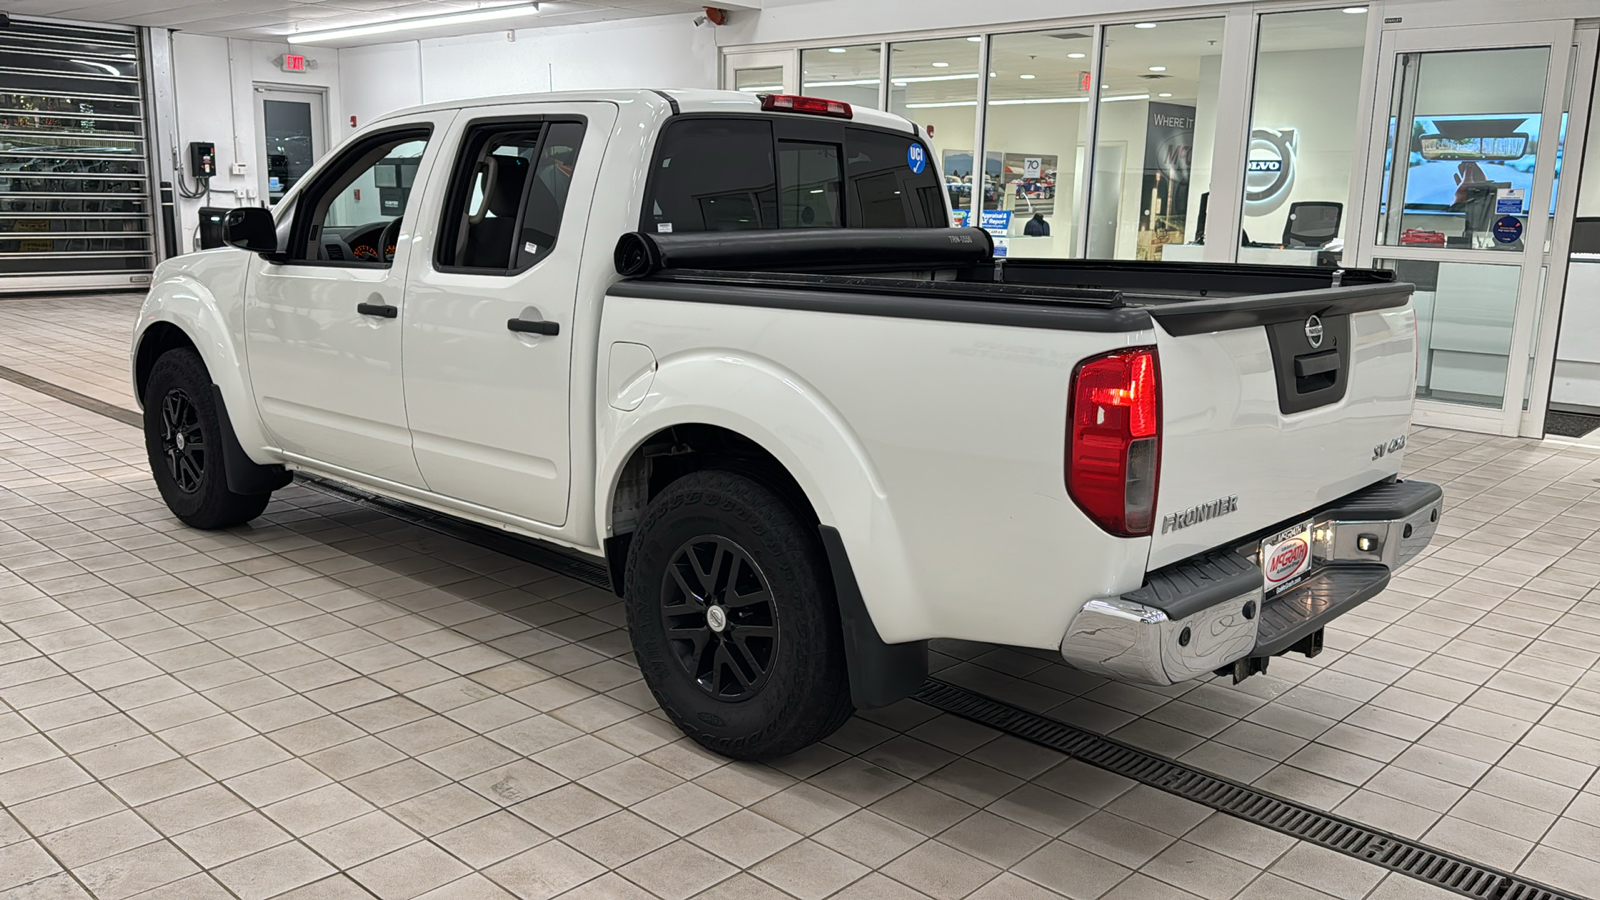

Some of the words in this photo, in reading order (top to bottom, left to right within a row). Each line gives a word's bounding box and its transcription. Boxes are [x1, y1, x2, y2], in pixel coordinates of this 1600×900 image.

[286, 54, 304, 70] EXIT
[910, 146, 923, 161] UCI
[1026, 160, 1040, 170] 70
[1372, 442, 1388, 461] SV
[1161, 493, 1239, 535] FRONTIER
